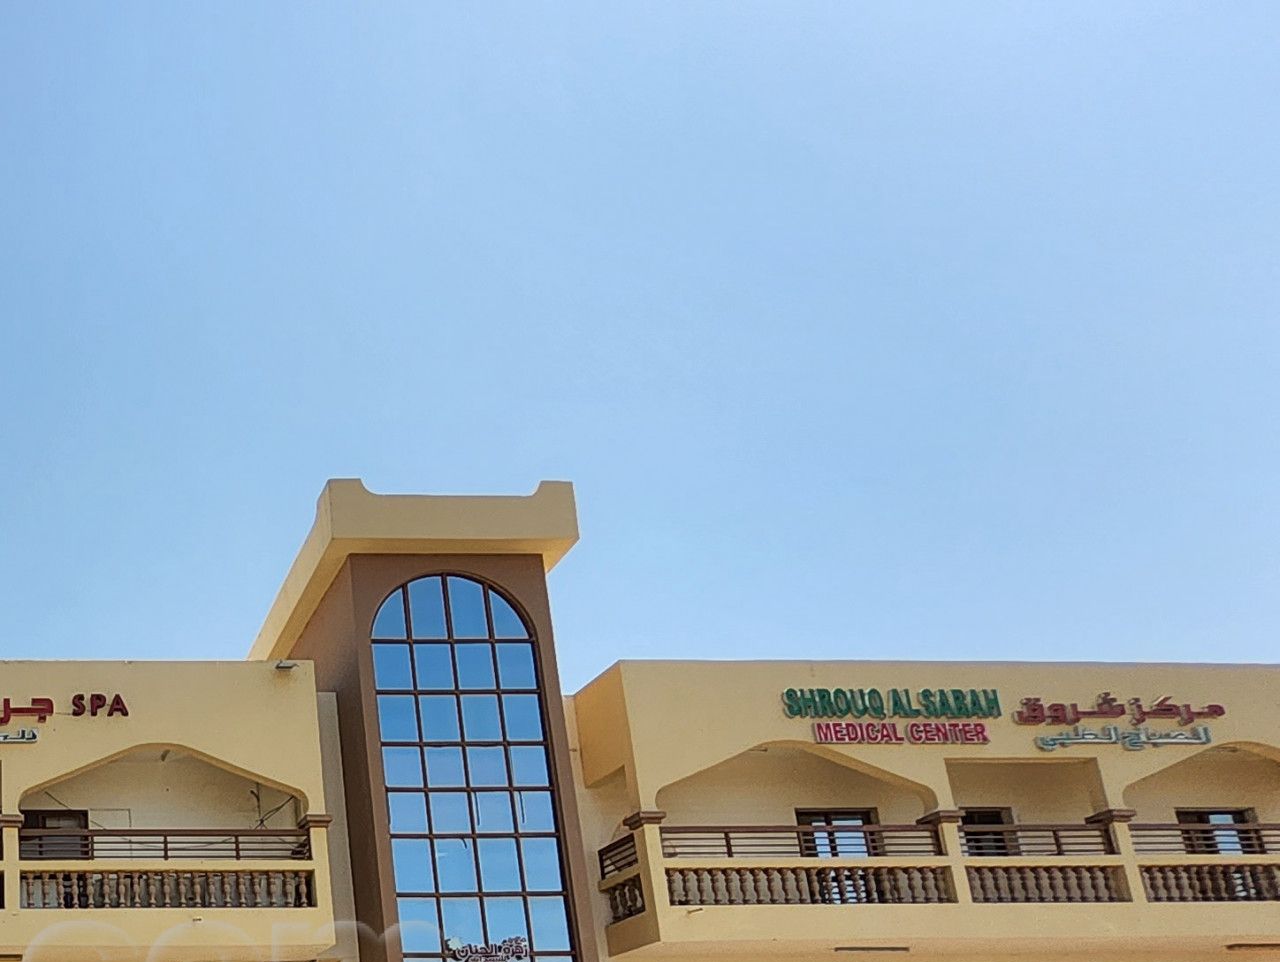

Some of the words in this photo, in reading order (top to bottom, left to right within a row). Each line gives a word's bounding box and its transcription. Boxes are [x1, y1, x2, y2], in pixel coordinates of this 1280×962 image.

[71, 693, 129, 717] SPA
[783, 688, 886, 720] SHROUQ
[1012, 692, 1126, 726] شروق
[1129, 696, 1225, 726] مركز
[813, 722, 904, 744] MEDICAL
[907, 722, 990, 744] CENTER
[1034, 725, 1121, 752] الطبي
[1122, 725, 1212, 751] الصباح
